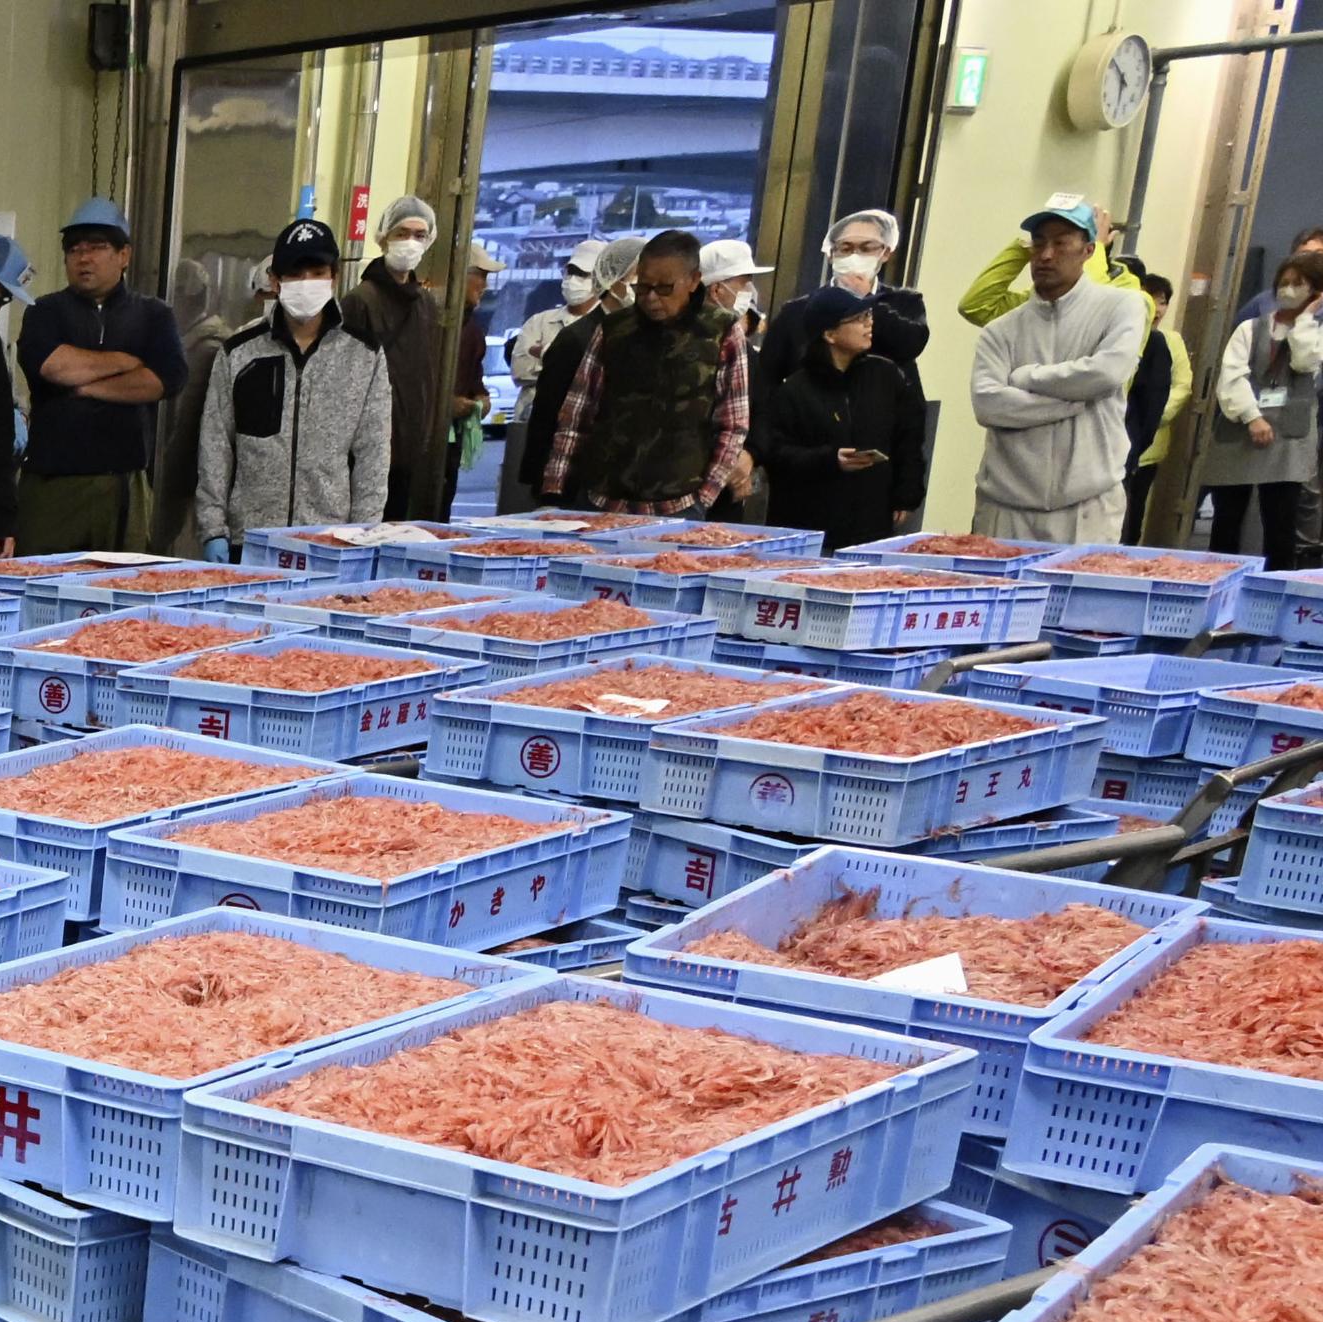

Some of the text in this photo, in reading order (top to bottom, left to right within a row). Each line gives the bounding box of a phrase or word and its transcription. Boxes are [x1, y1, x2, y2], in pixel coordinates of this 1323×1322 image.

[754, 599, 801, 631] 望月
[360, 699, 427, 733] 金比羅丸
[448, 874, 546, 929] かきや
